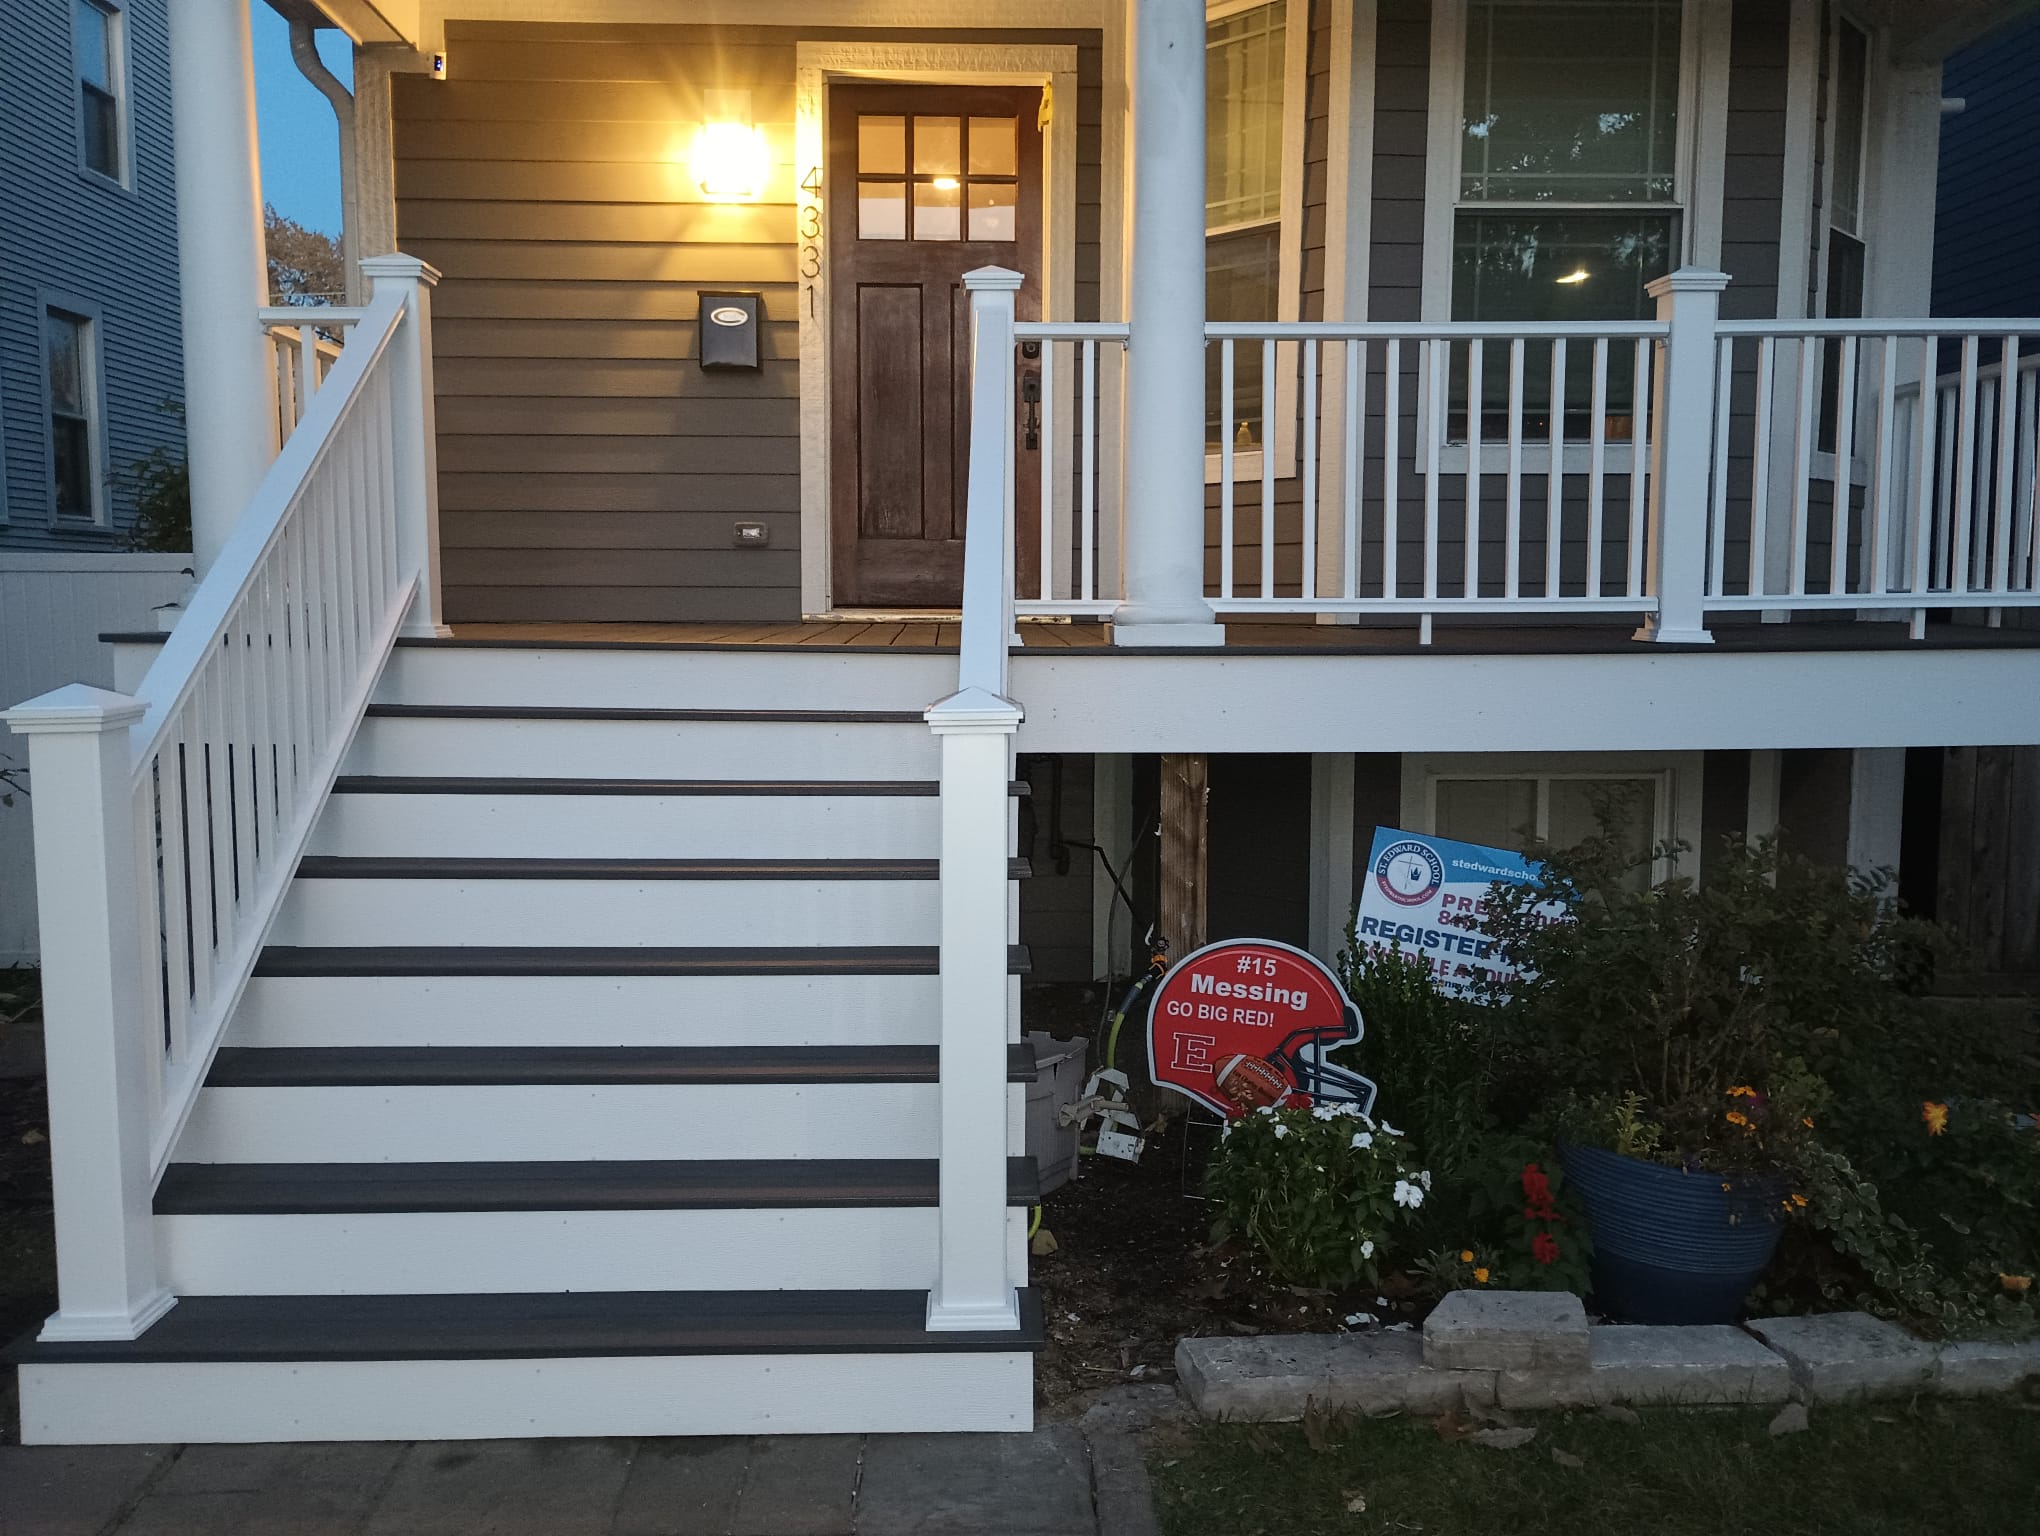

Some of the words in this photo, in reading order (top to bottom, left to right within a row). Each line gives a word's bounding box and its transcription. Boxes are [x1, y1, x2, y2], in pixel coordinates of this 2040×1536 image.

[801, 166, 821, 318] 4331
[1383, 844, 1421, 862] EDWARD
[1420, 849, 1441, 885] SCHOOL
[1451, 859, 1540, 882] stedwardscho
[1237, 956, 1276, 976] #15
[1191, 973, 1308, 1011] Messing
[1167, 1001, 1193, 1017] GO
[1197, 1004, 1228, 1021] BIG
[1233, 1009, 1274, 1028] RED!
[1171, 1032, 1216, 1073] E
